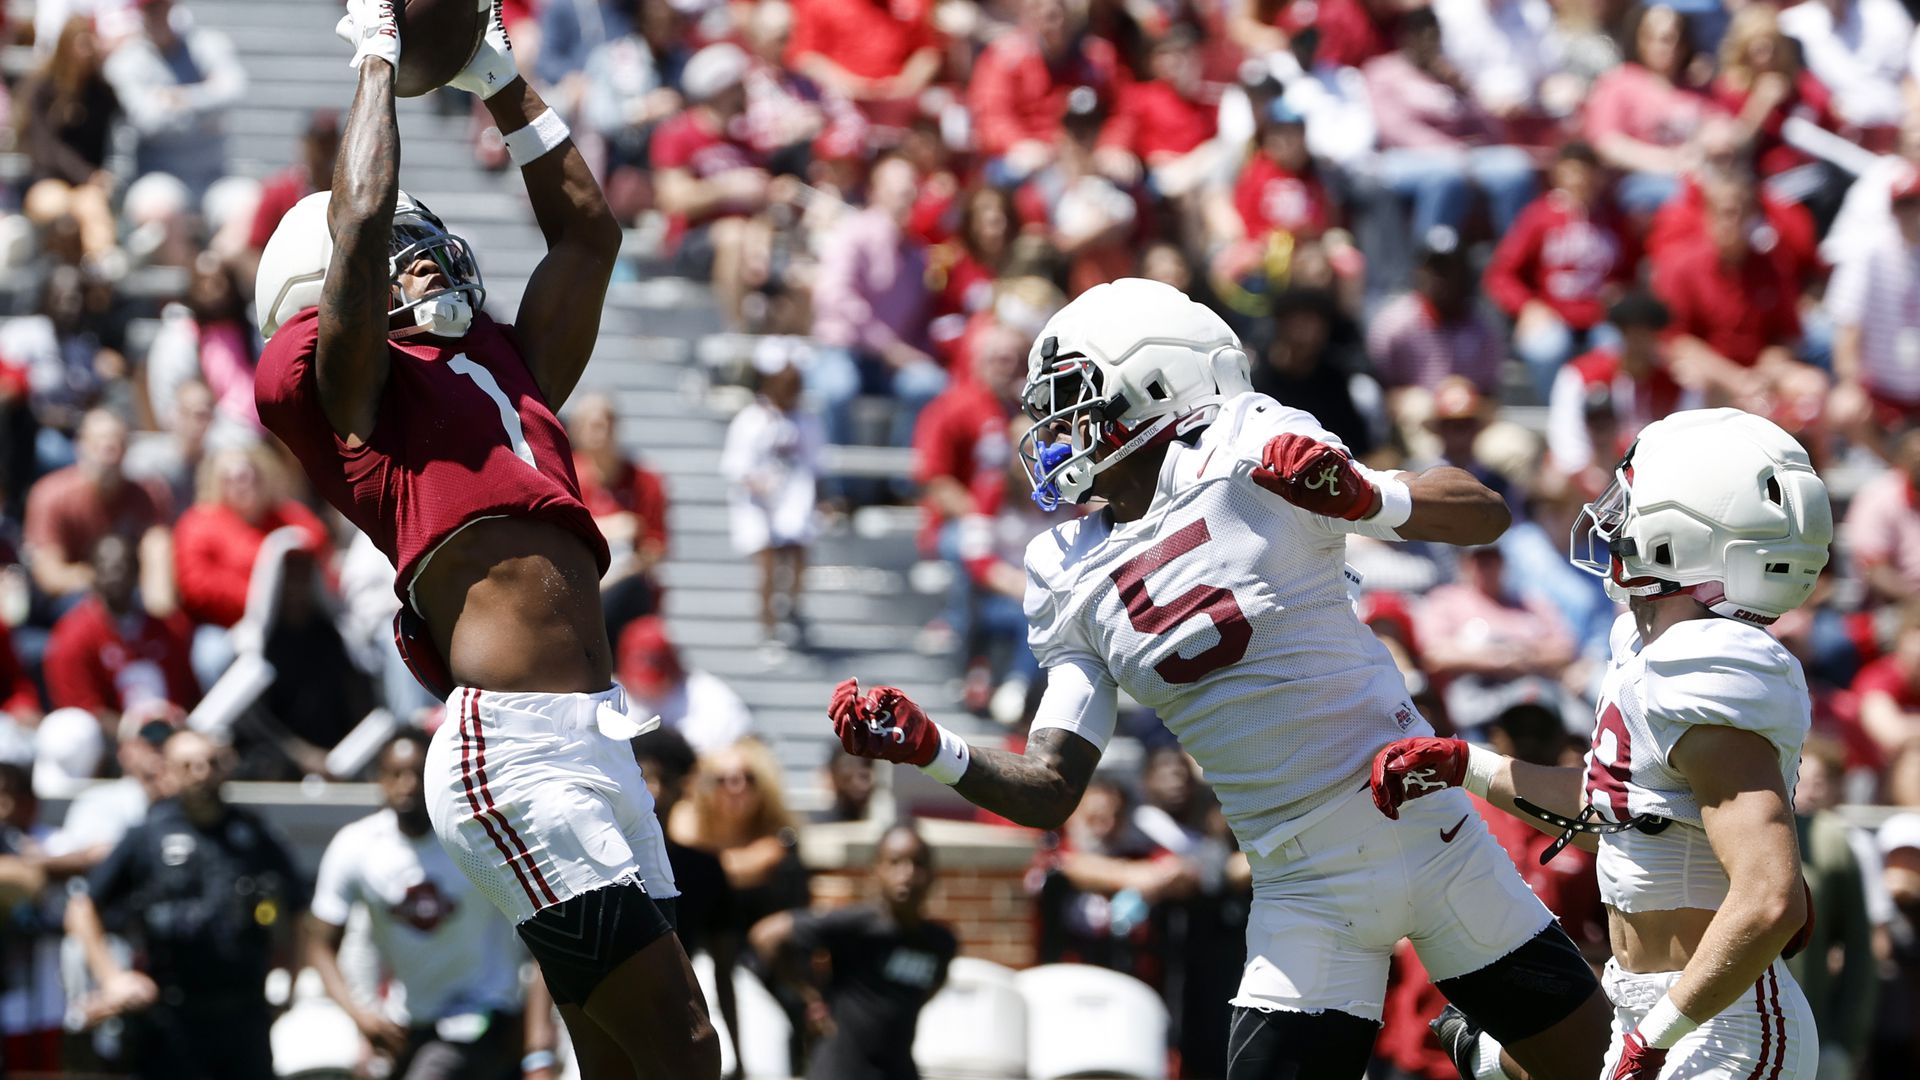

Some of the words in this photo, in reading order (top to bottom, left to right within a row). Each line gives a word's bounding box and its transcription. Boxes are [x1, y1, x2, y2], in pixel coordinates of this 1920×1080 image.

[446, 352, 538, 471] 1
[1114, 436, 1145, 461] CRIMSON
[1143, 424, 1160, 439] TIDE
[1304, 464, 1341, 497] A
[1109, 517, 1253, 684] 5
[1648, 585, 1661, 593] TID
[1586, 696, 1632, 824] 8
